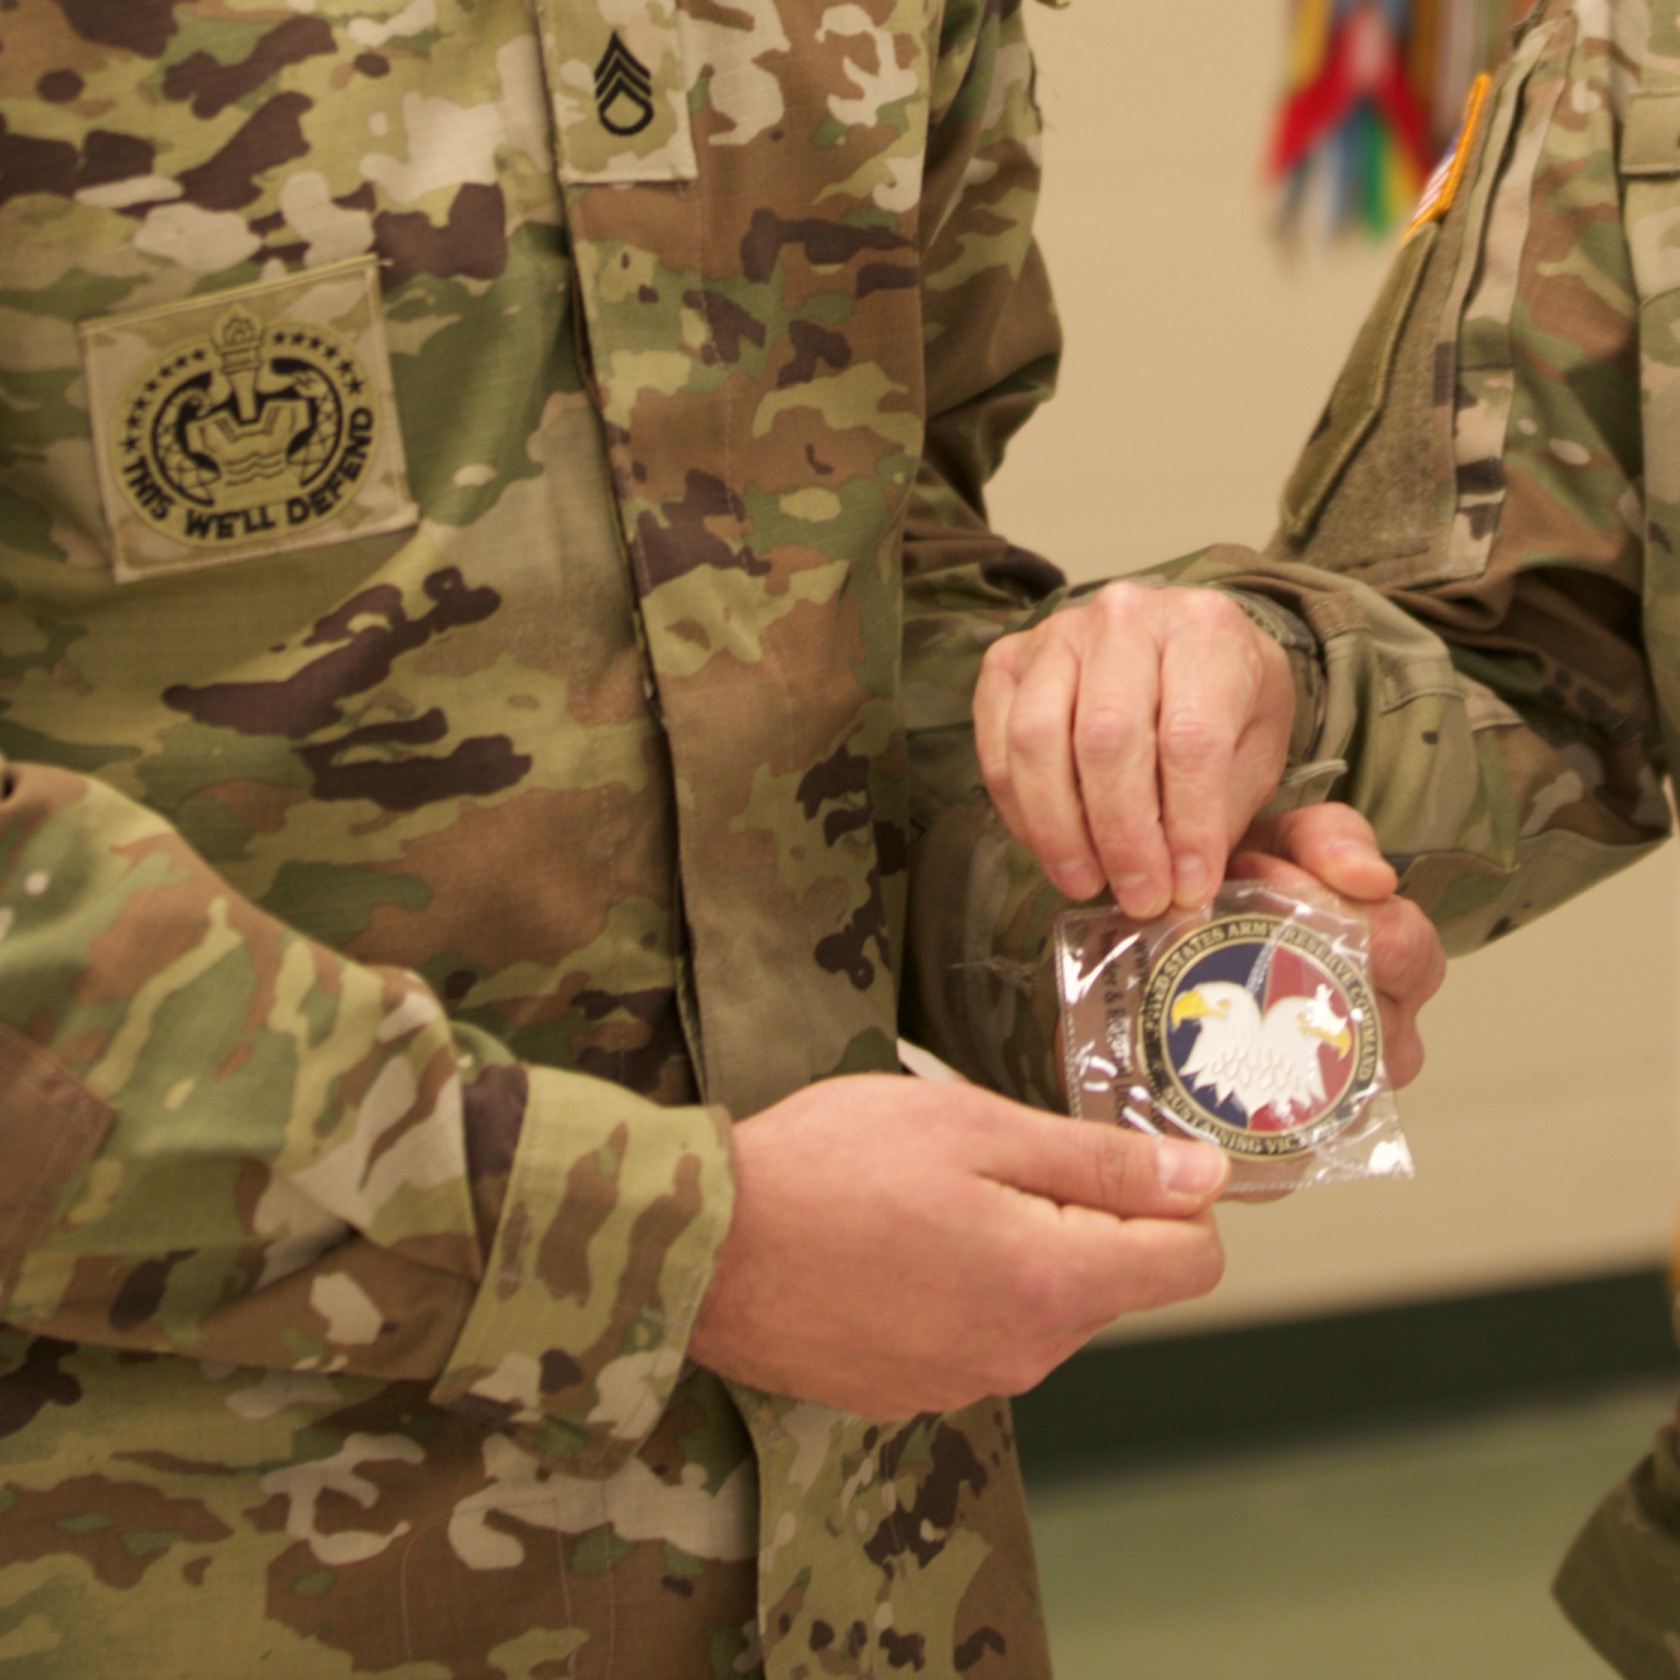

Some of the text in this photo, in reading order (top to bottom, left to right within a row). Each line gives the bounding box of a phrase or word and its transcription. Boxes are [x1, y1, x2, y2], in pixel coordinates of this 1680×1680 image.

[123, 454, 175, 520] THIS
[286, 406, 373, 526] DEFEND
[1163, 926, 1226, 976] STATES
[1349, 985, 1377, 1082] COMMAND
